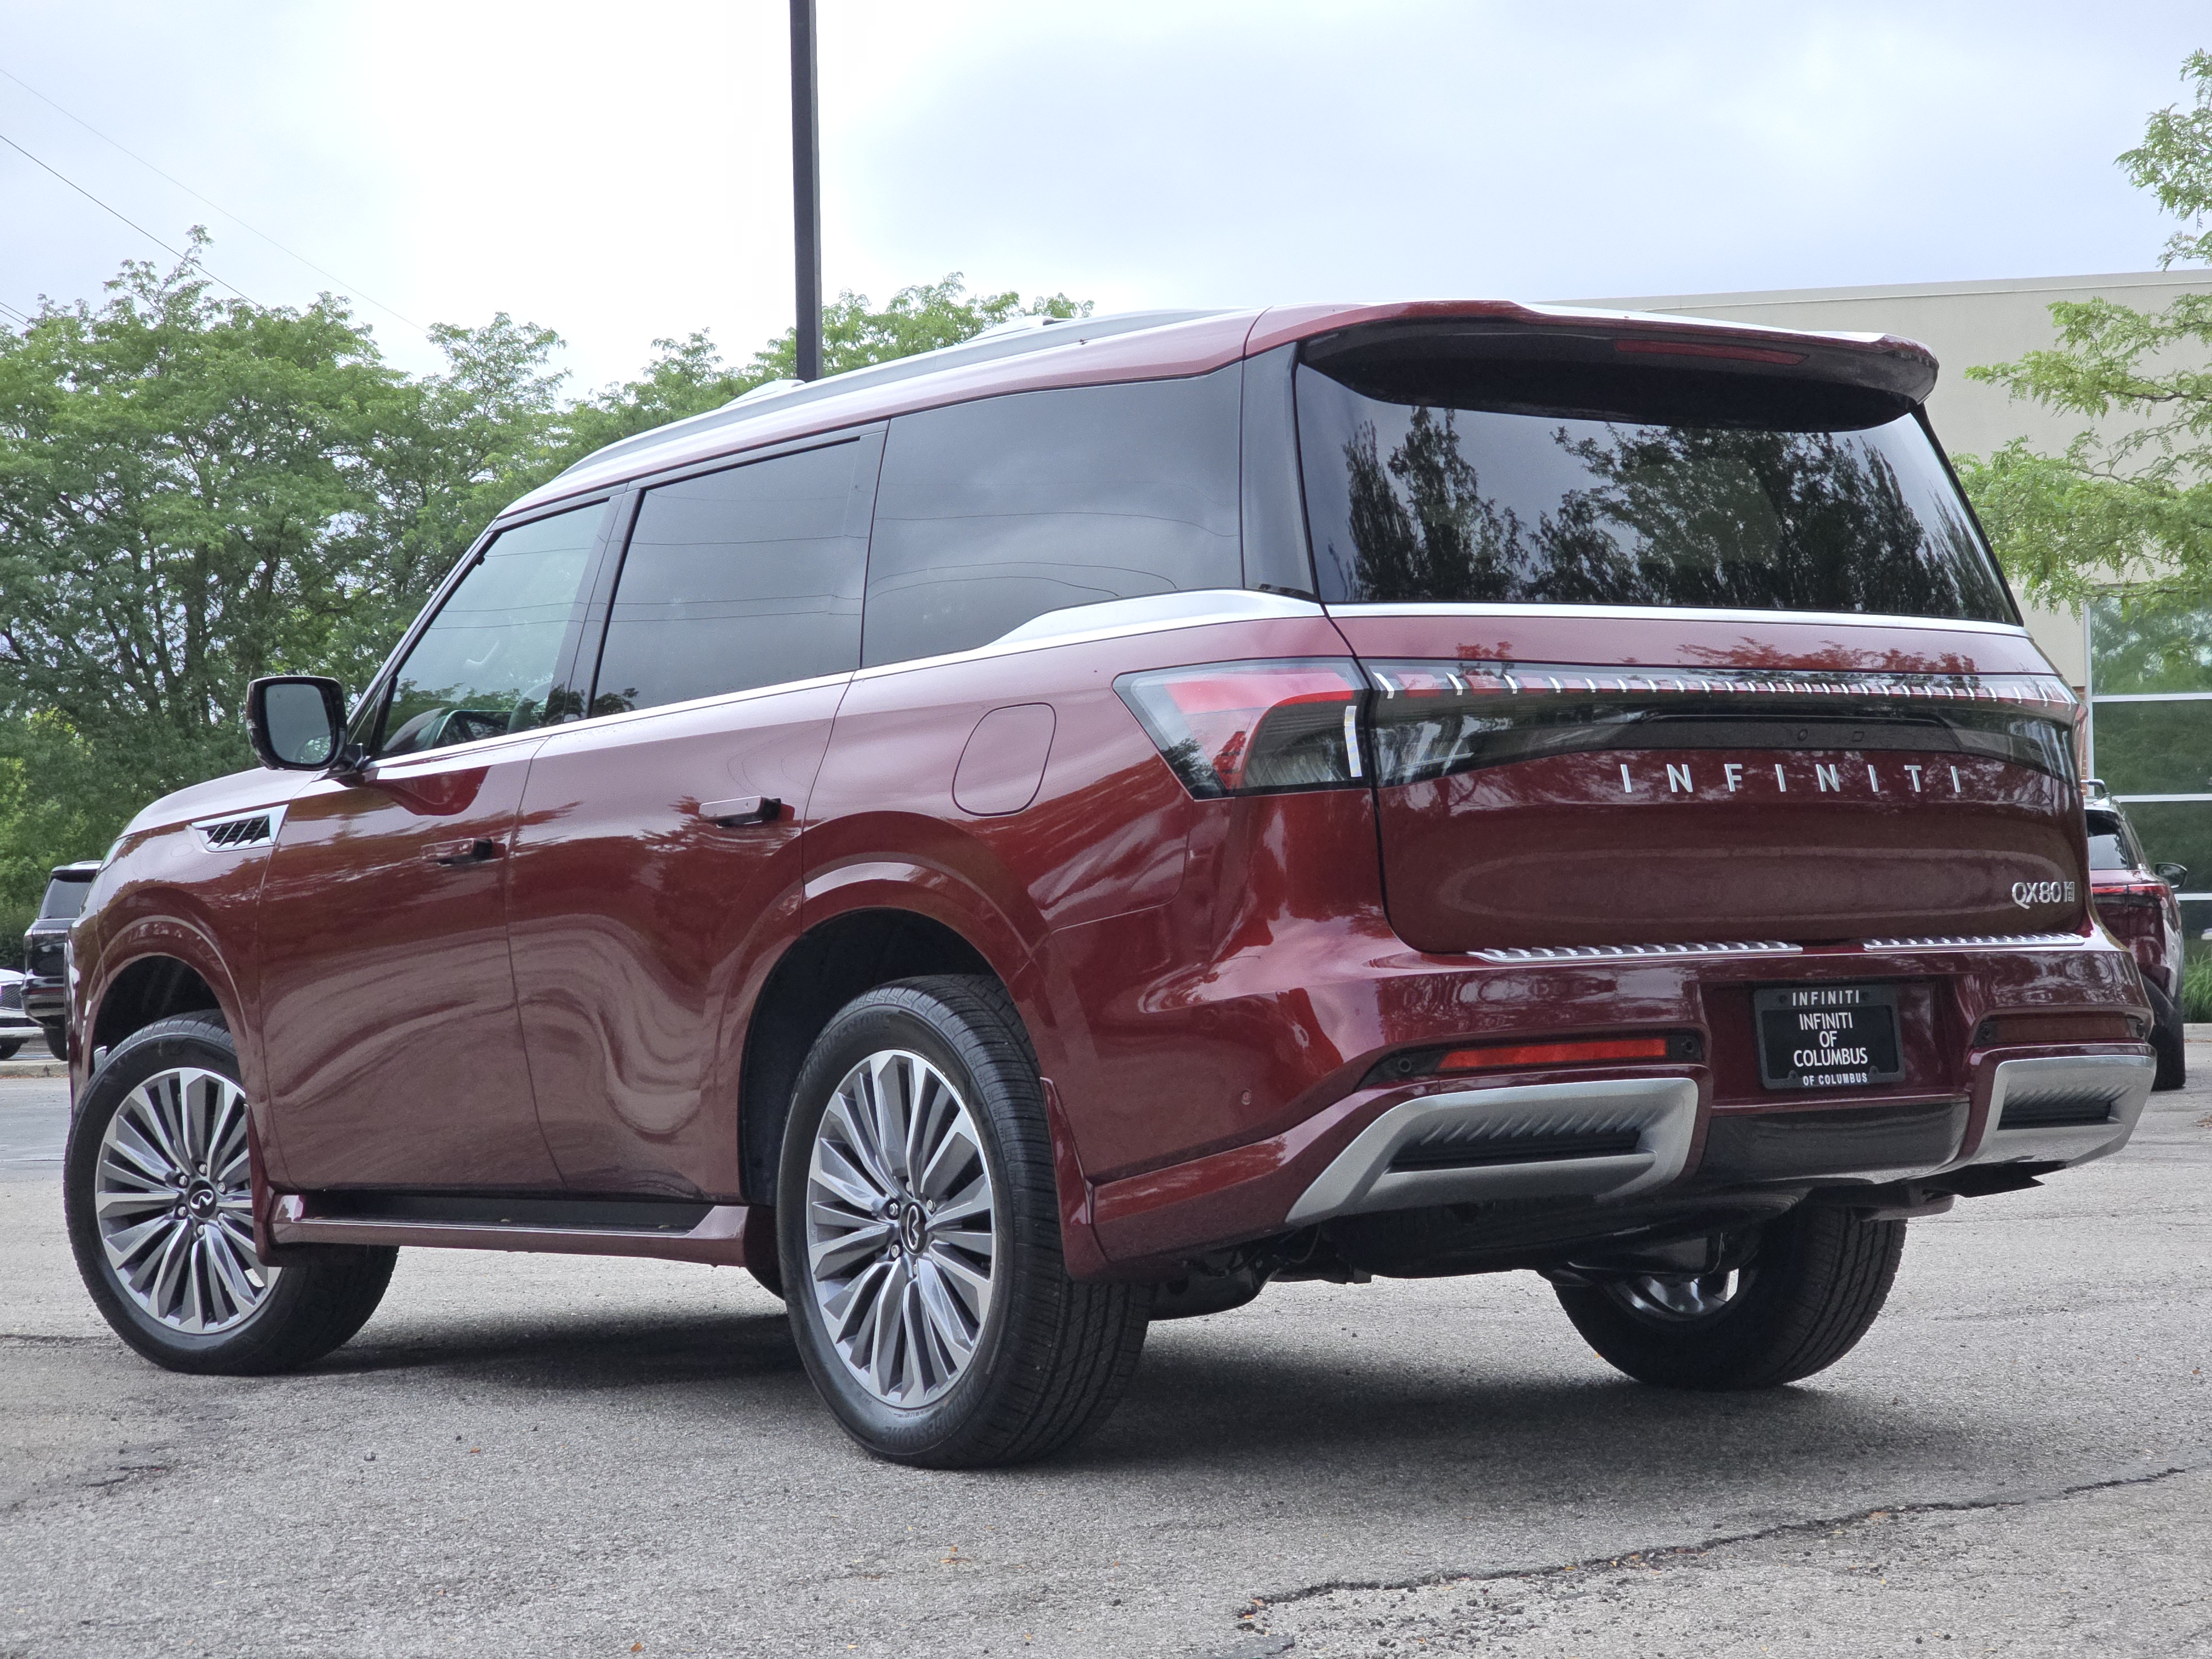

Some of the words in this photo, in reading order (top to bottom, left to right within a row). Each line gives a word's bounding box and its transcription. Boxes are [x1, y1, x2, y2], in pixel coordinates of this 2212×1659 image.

[1620, 764, 1961, 793] INFINITI
[2012, 881, 2062, 909] QX80
[1792, 990, 1859, 1006] INFINITI
[1799, 1012, 1853, 1030] INFINITI
[1819, 1031, 1838, 1047] OF
[1793, 1047, 1868, 1067] COLUMBUS
[1803, 1074, 1815, 1086] OF
[1818, 1072, 1868, 1085] COLUMBUS
